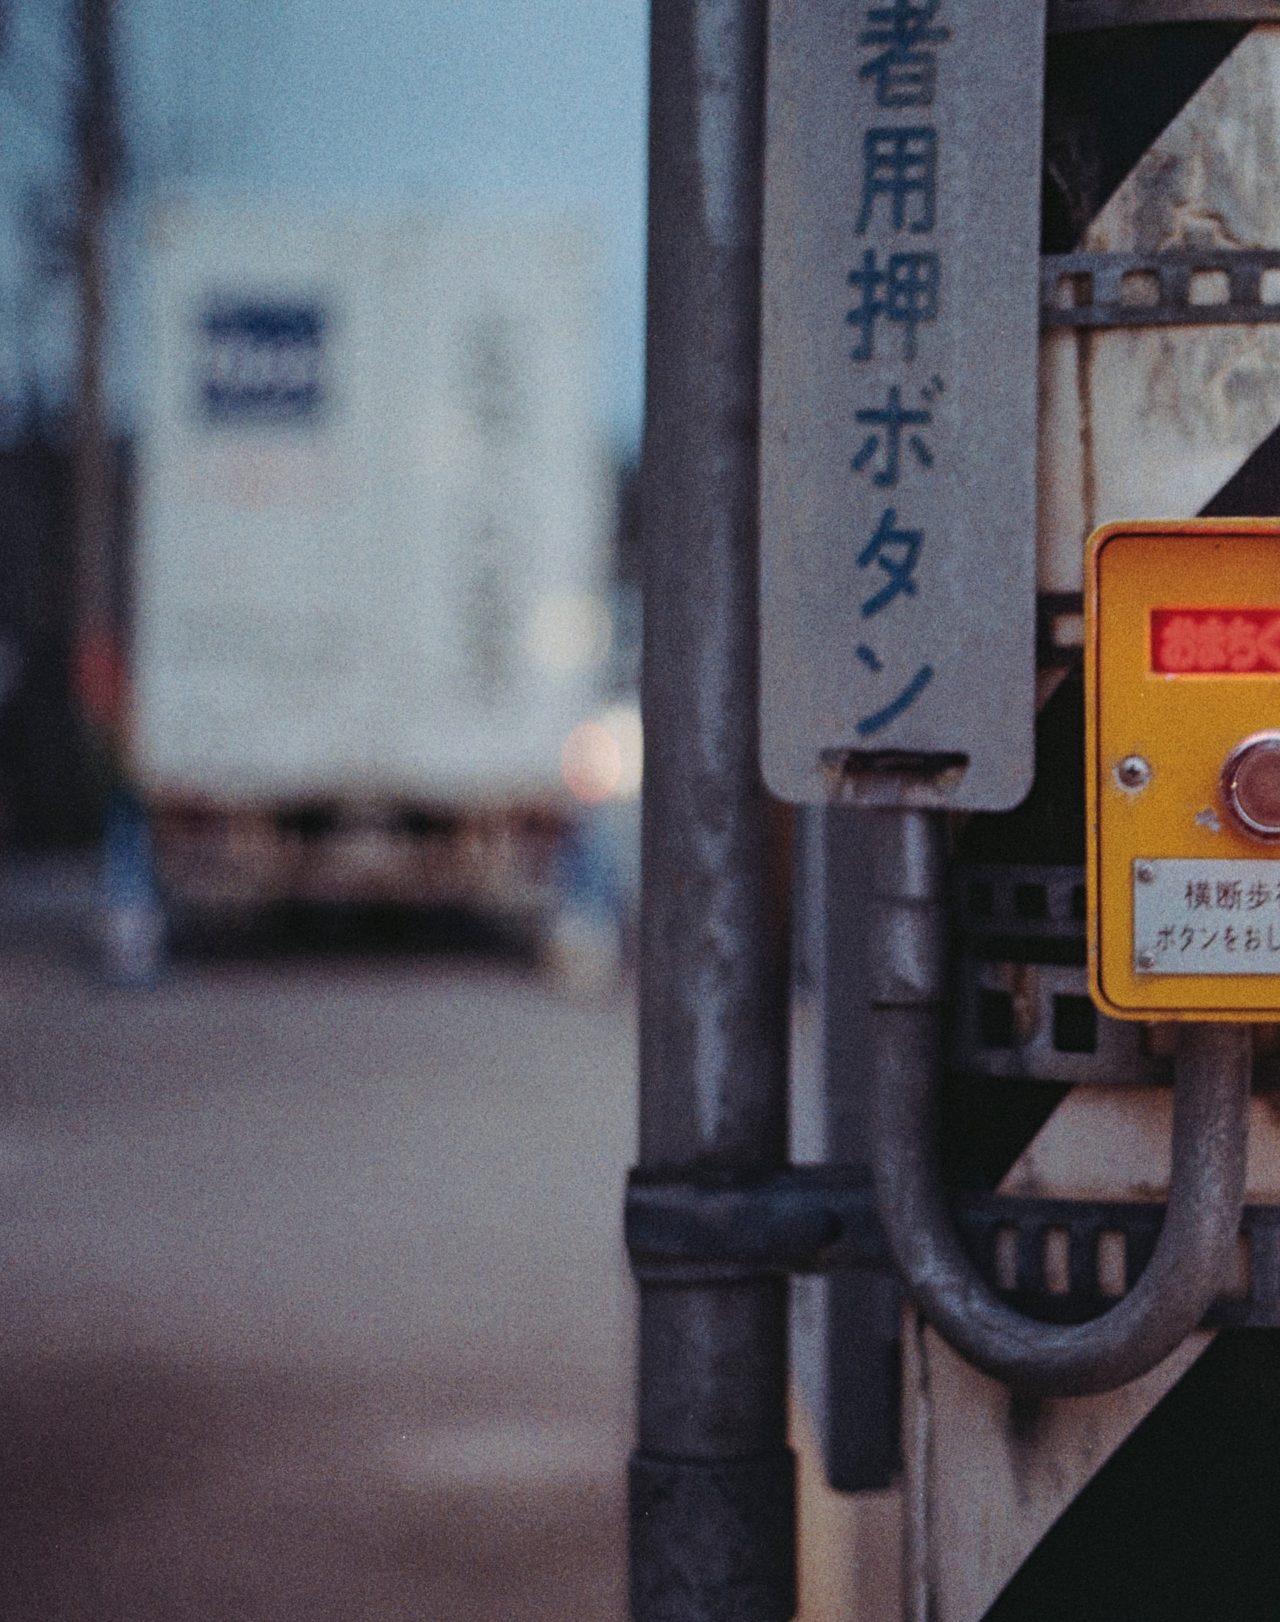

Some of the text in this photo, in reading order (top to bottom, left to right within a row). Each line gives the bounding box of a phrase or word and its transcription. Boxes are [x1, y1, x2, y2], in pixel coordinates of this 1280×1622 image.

[846, 0, 951, 736] 者用押ボタン
